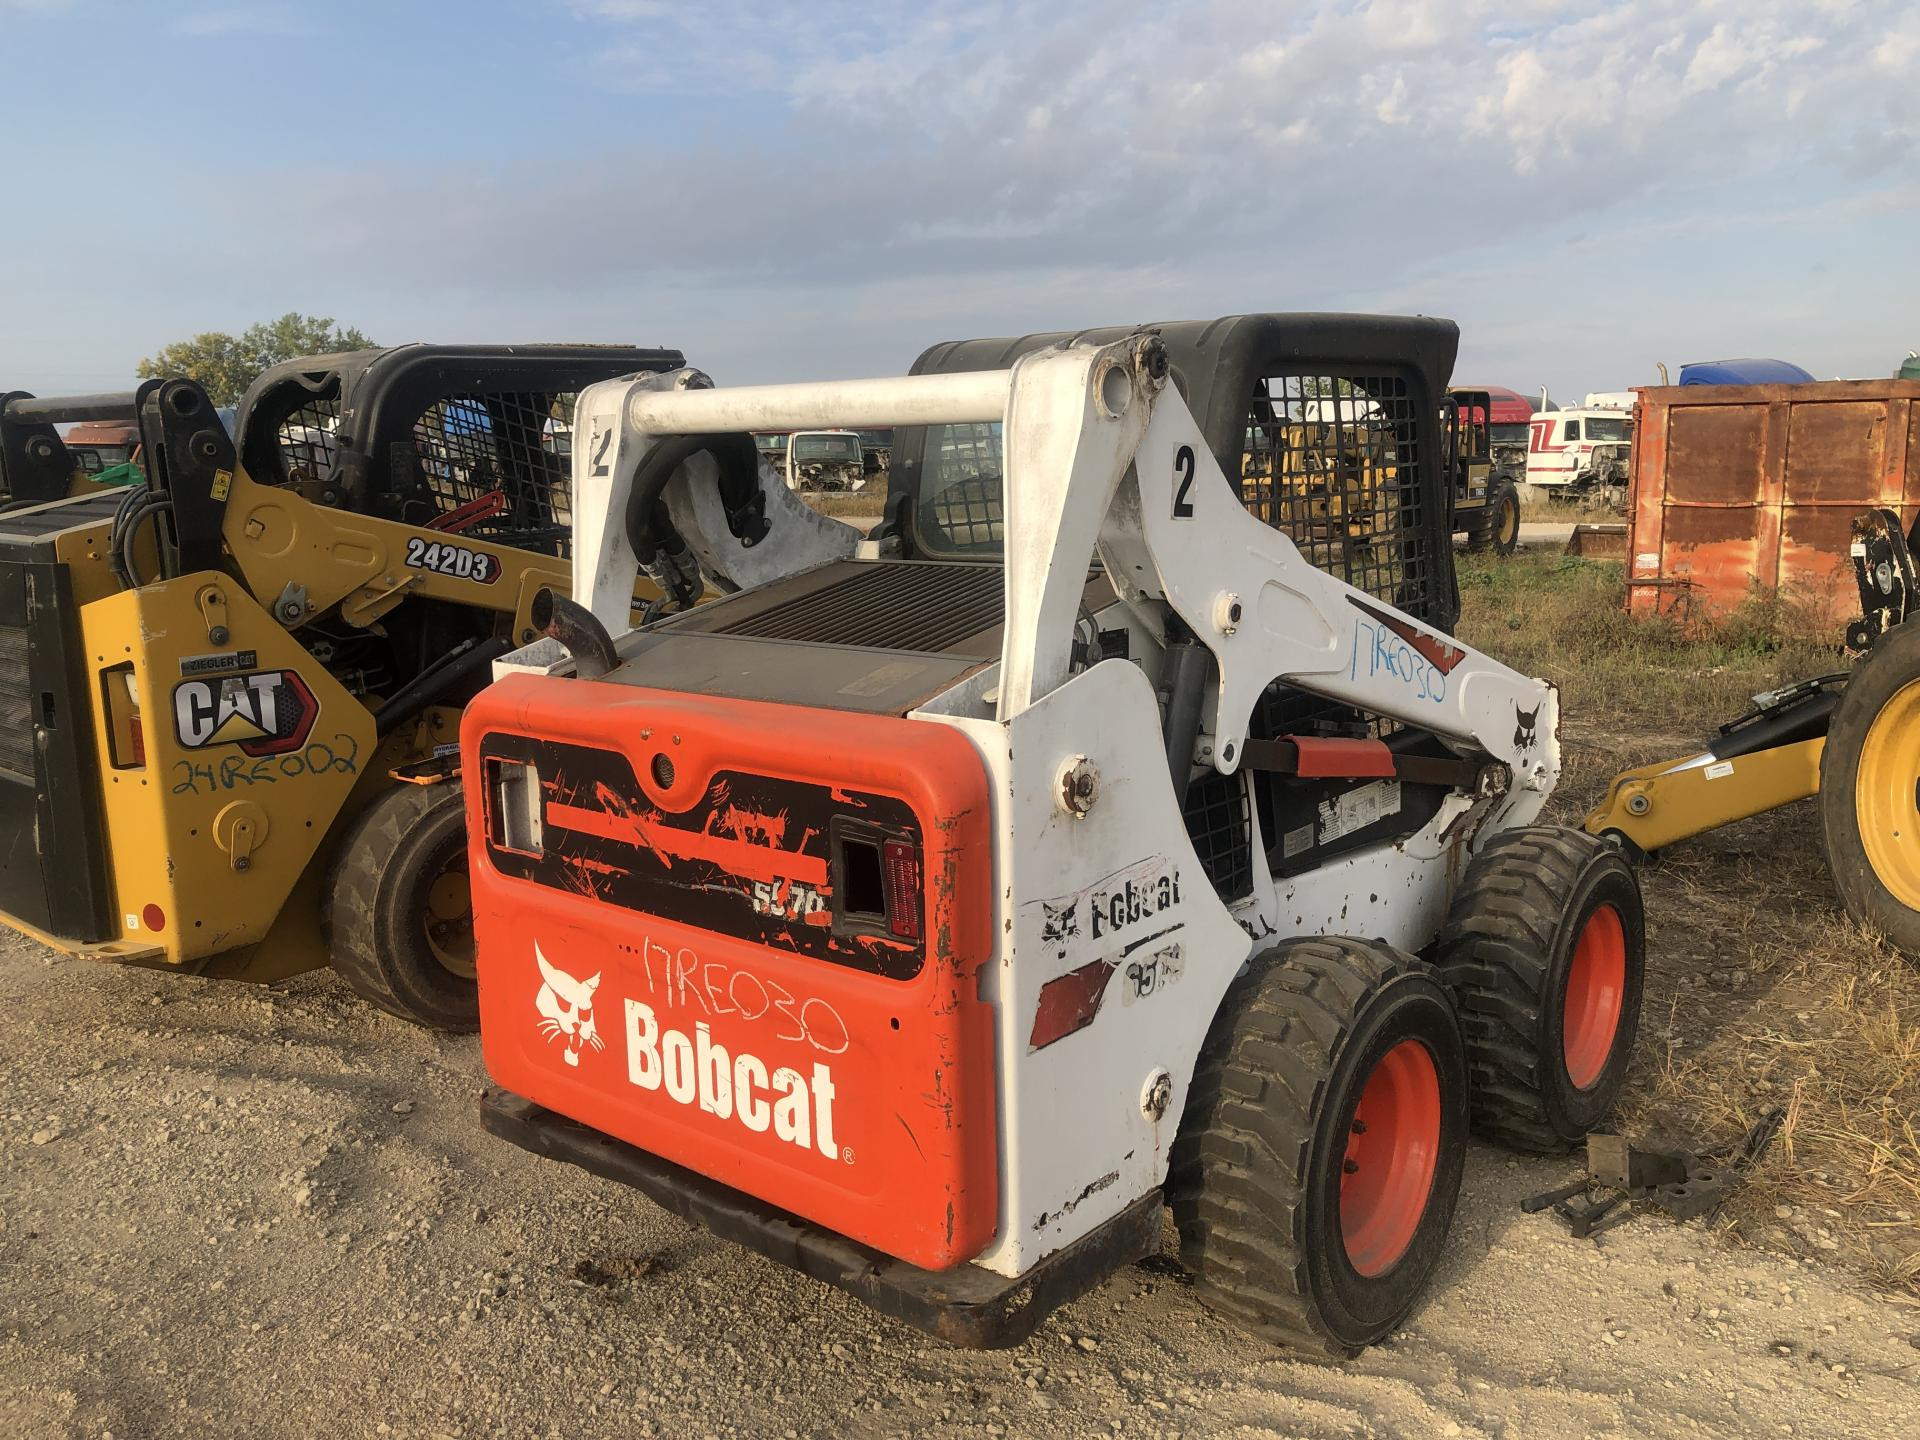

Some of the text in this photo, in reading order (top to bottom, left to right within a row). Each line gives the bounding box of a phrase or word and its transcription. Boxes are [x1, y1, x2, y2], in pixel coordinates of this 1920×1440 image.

[1173, 445, 1196, 518] 2
[406, 538, 488, 581] 242D3
[190, 658, 234, 672] ZIEGLER
[175, 672, 282, 747] CAT
[624, 997, 838, 1161] Bobcat
